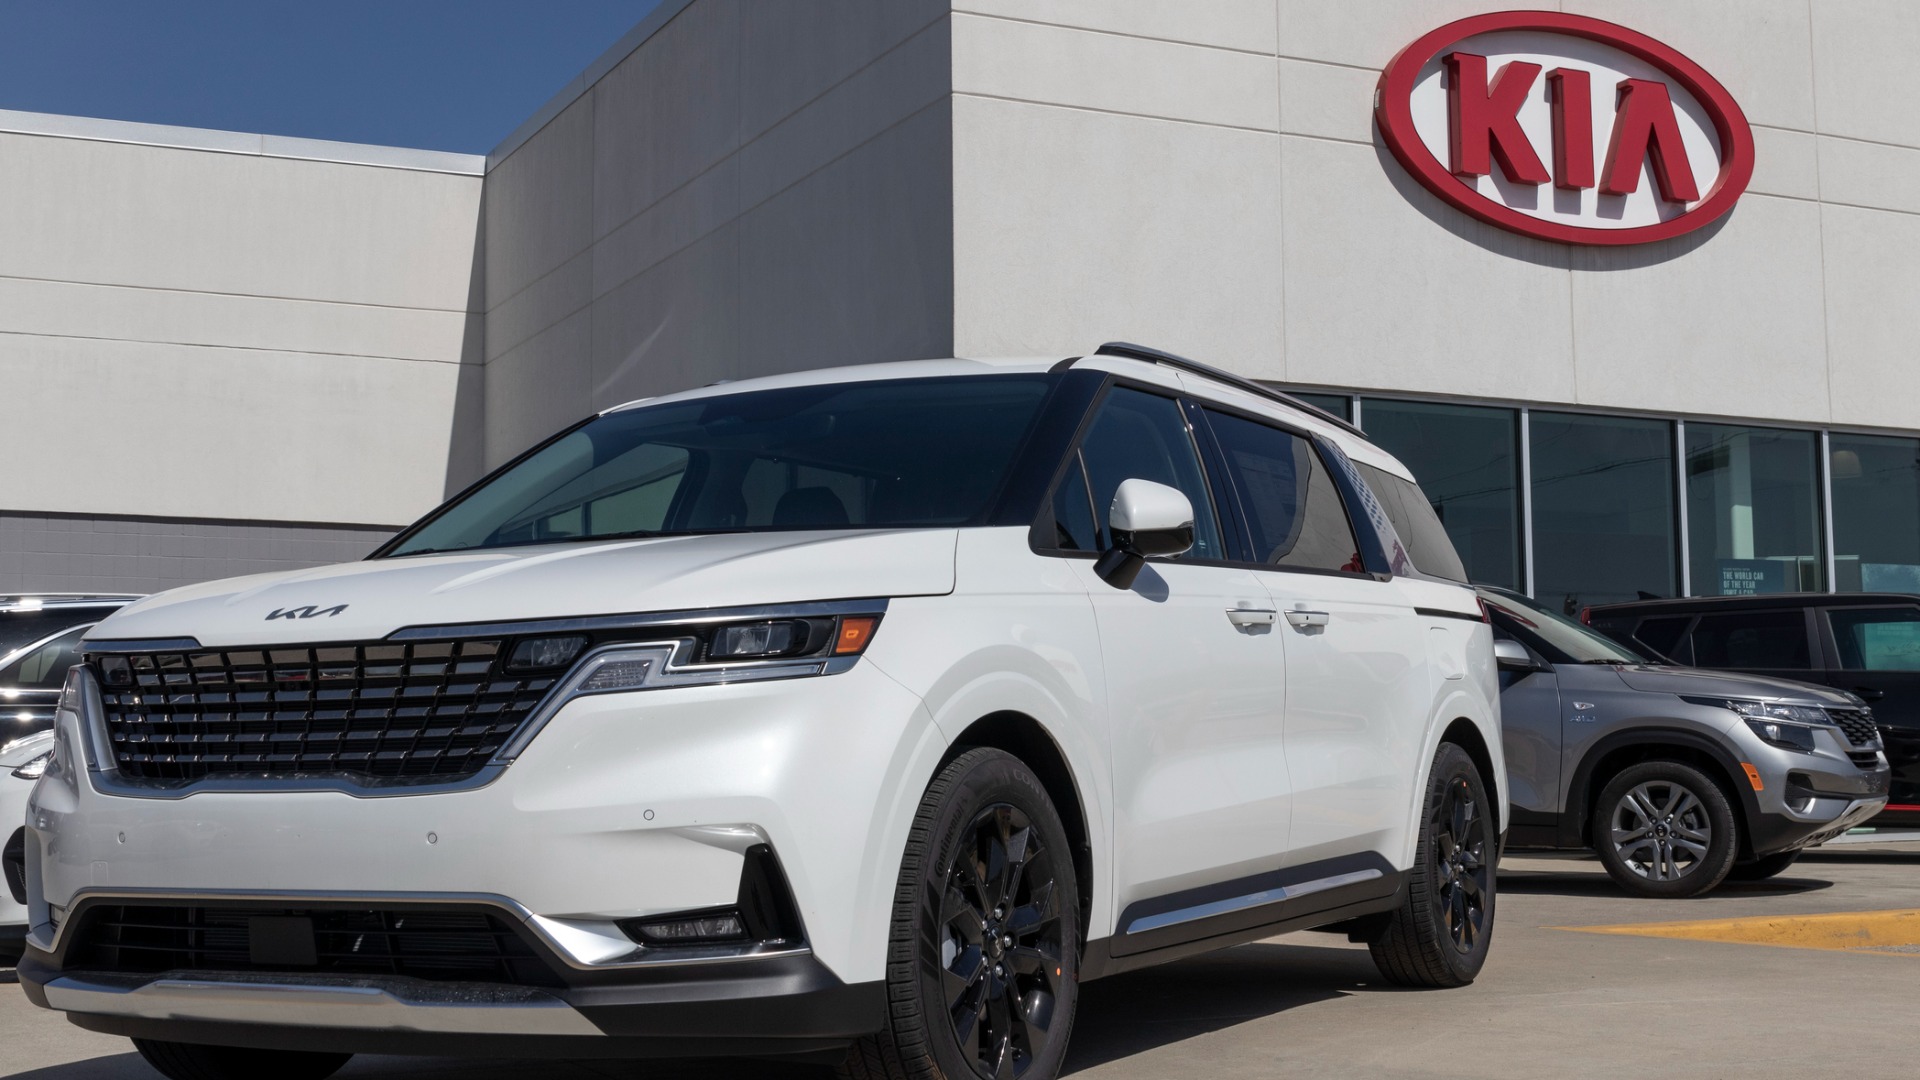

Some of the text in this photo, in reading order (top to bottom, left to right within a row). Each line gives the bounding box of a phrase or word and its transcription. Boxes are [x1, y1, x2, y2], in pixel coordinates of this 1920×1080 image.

[1441, 51, 1701, 204] KIA
[1723, 571, 1764, 580] THE WORLD CAR
[1723, 580, 1756, 589] OF THE YEAR
[934, 802, 964, 878] Continental
